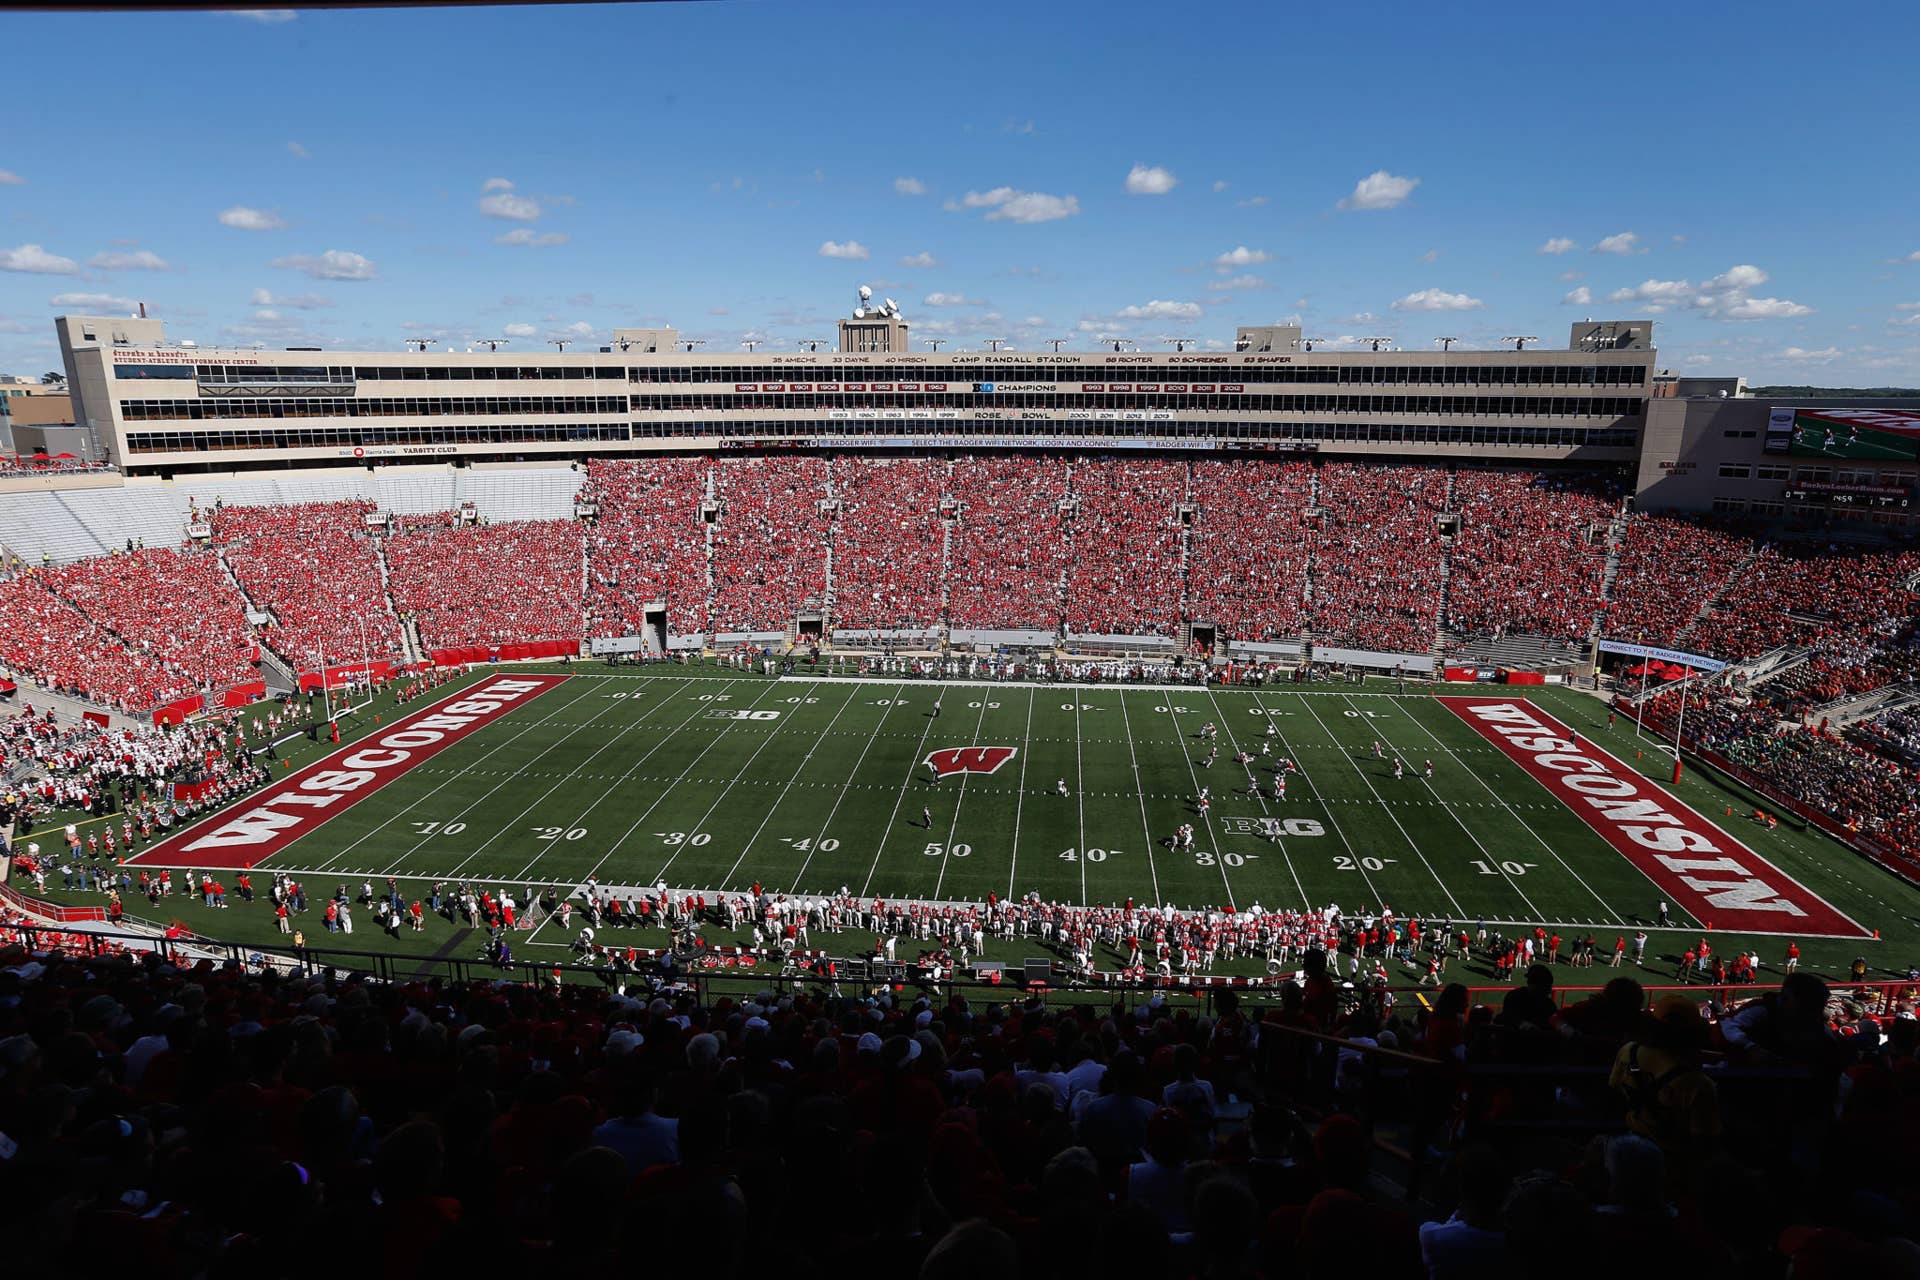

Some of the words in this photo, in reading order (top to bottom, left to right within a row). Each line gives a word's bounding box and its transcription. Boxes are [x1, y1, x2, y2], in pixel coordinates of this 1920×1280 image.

[997, 384, 1057, 392] CHAMPIONS
[1602, 643, 1630, 653] CONNECT
[1656, 650, 1681, 661] BADGER
[1694, 657, 1723, 670] NETWORK
[179, 679, 545, 851] WISCONSIN
[921, 747, 1018, 778] W
[1467, 704, 1809, 917] WISCONSIN
[415, 822, 467, 836] 10
[536, 826, 588, 841] 20
[663, 832, 712, 846] 30
[791, 838, 840, 852] 40
[924, 843, 972, 857] 50
[1058, 847, 1107, 862] 40
[1195, 851, 1245, 867] 30
[1332, 855, 1384, 871] 20
[1469, 860, 1527, 876] 10
